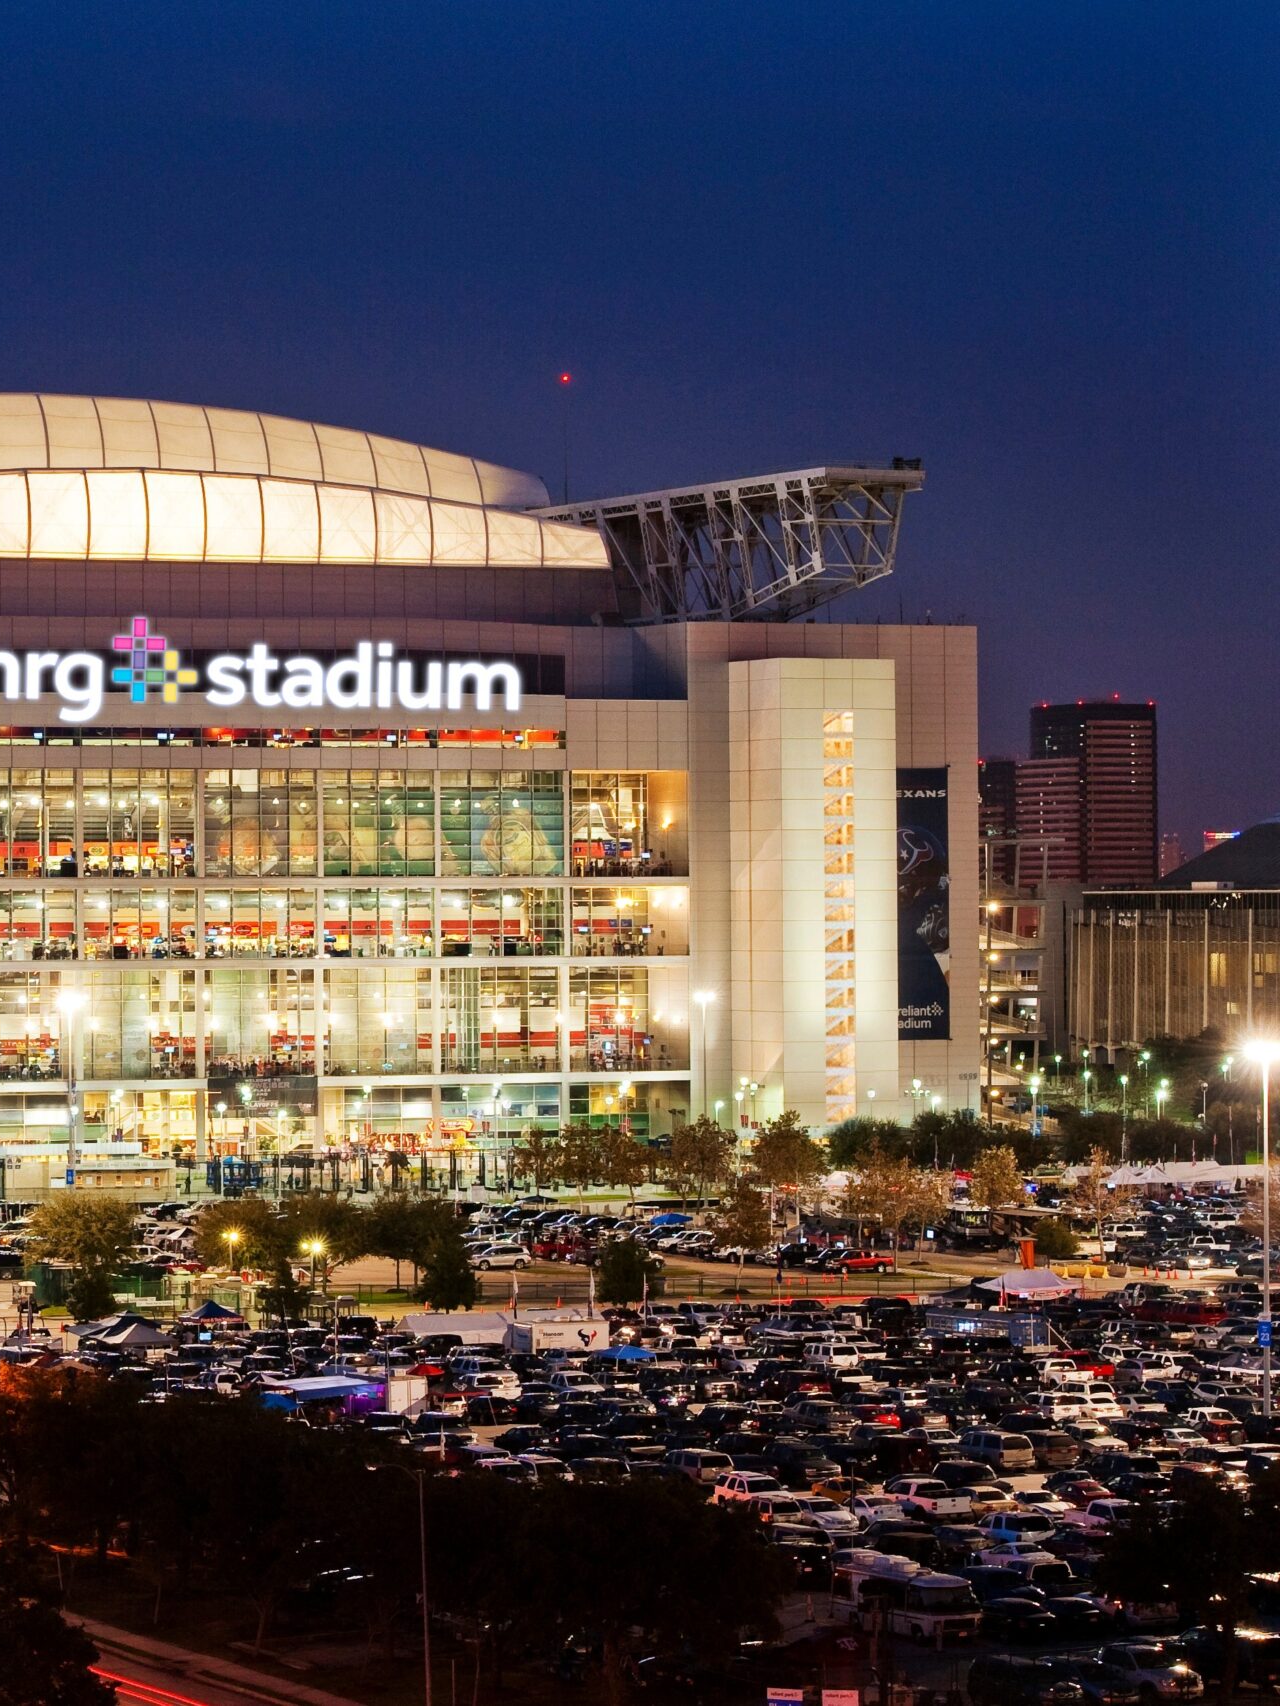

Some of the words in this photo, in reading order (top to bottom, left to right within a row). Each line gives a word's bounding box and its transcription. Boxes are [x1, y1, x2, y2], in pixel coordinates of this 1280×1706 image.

[206, 642, 521, 711] stadium
[896, 789, 947, 798] EXANS
[898, 1017, 932, 1029] adium
[1260, 1332, 1270, 1342] 23
